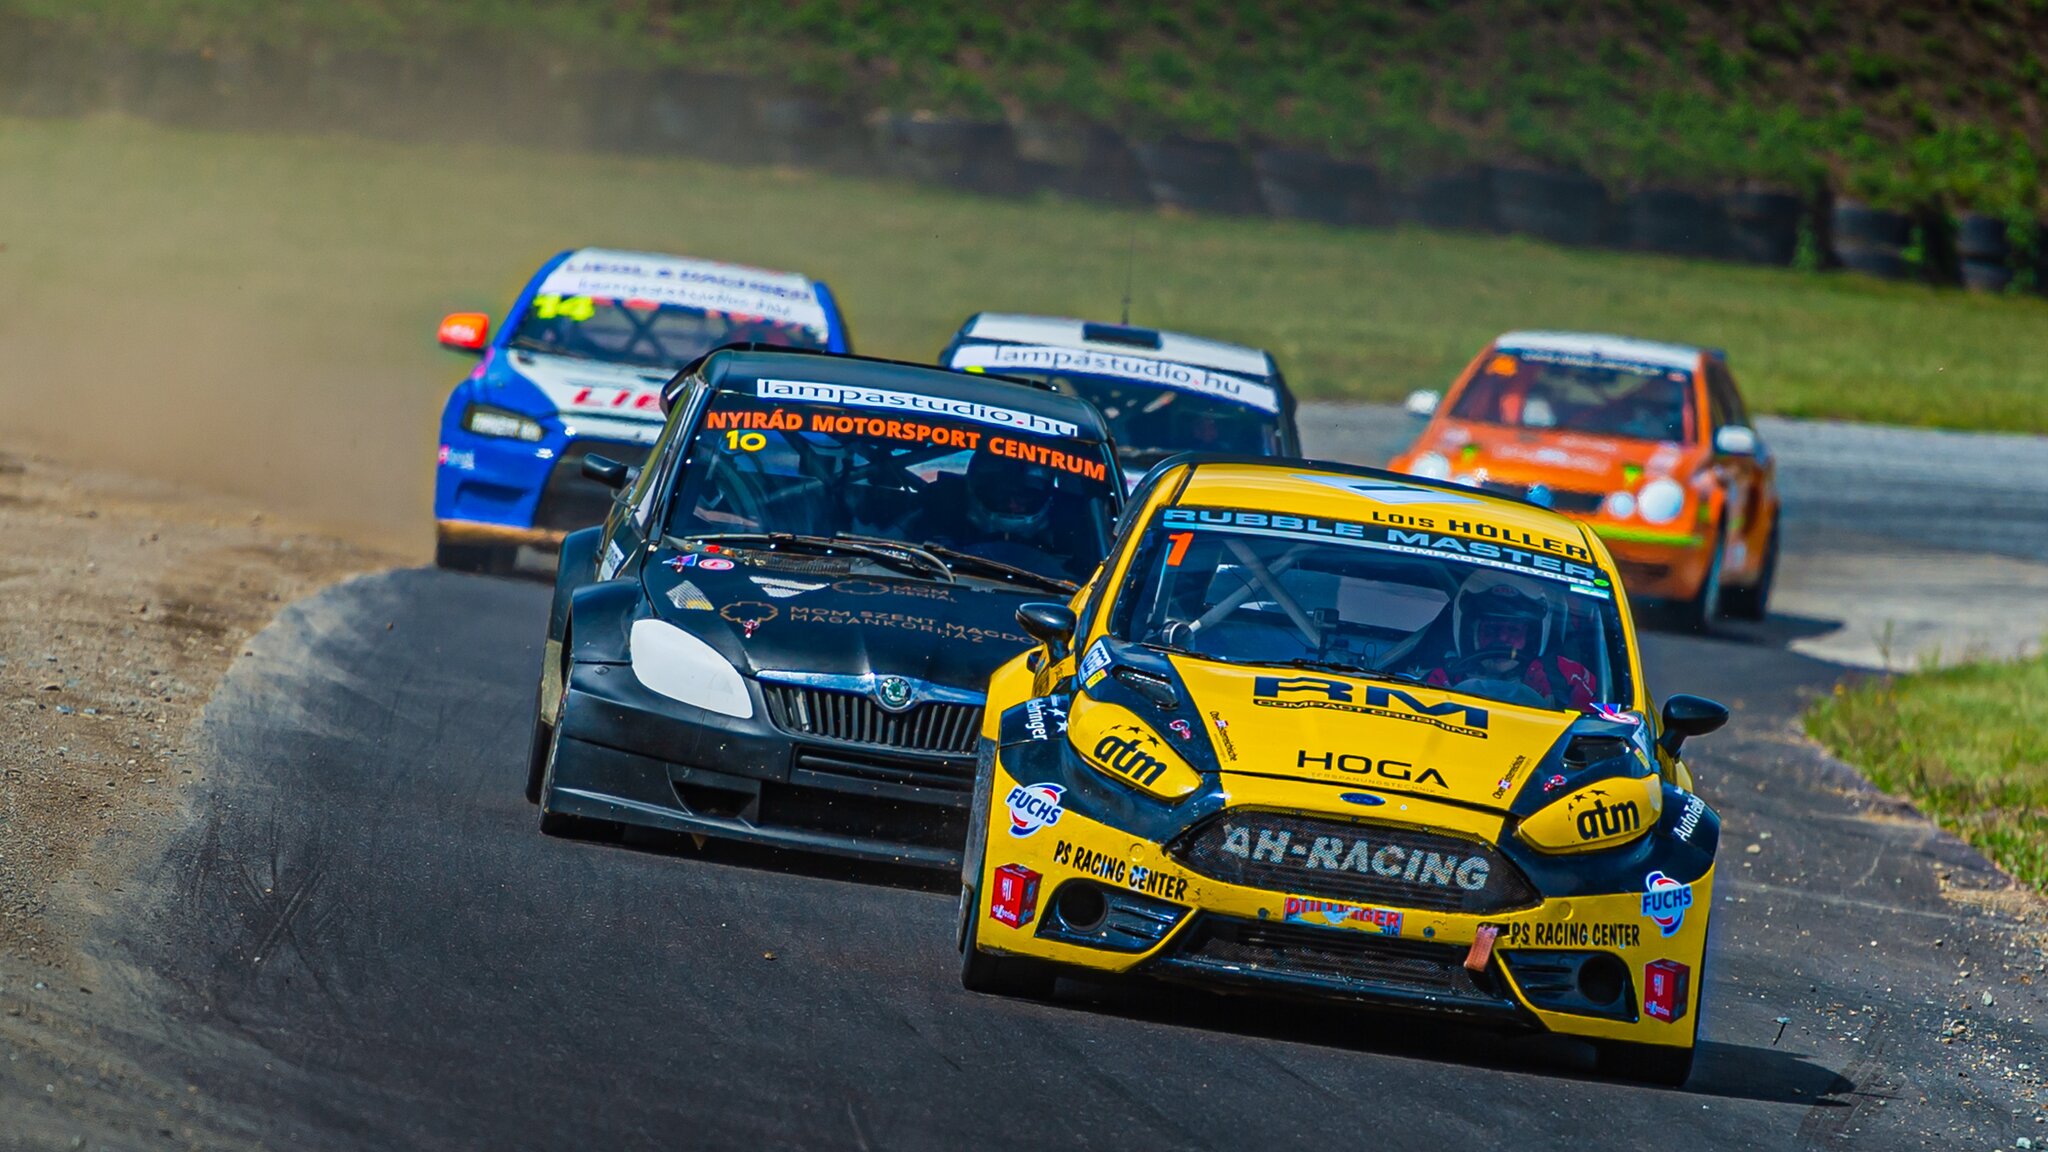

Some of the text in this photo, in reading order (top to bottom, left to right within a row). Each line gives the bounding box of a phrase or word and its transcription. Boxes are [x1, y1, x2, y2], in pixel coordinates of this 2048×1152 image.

[994, 345, 1242, 396] lampastudio.hu
[763, 381, 1076, 436] lampastudio.hu
[706, 409, 1107, 481] NYIRÁD MOTORSPORT CENTRUM
[726, 429, 767, 451] 10
[1372, 511, 1435, 528] LOIS
[1163, 509, 1597, 581] RUBBLE MASTER
[1167, 532, 1194, 567] 1
[790, 606, 851, 617] MOM
[946, 622, 1038, 644] MAGDO
[1253, 676, 1489, 730] RM
[1257, 699, 1485, 737] COMPACT CRUSHING
[1093, 735, 1168, 787] atm
[1297, 749, 1450, 790] HOGA
[1006, 788, 1062, 825] FUCHS
[1576, 797, 1641, 841] atm
[1053, 840, 1188, 901] PS RACING CENTER
[1221, 824, 1491, 891] AH-RACING
[1642, 886, 1692, 914] FUCHS
[1511, 922, 1641, 947] PS RACING CENTER
